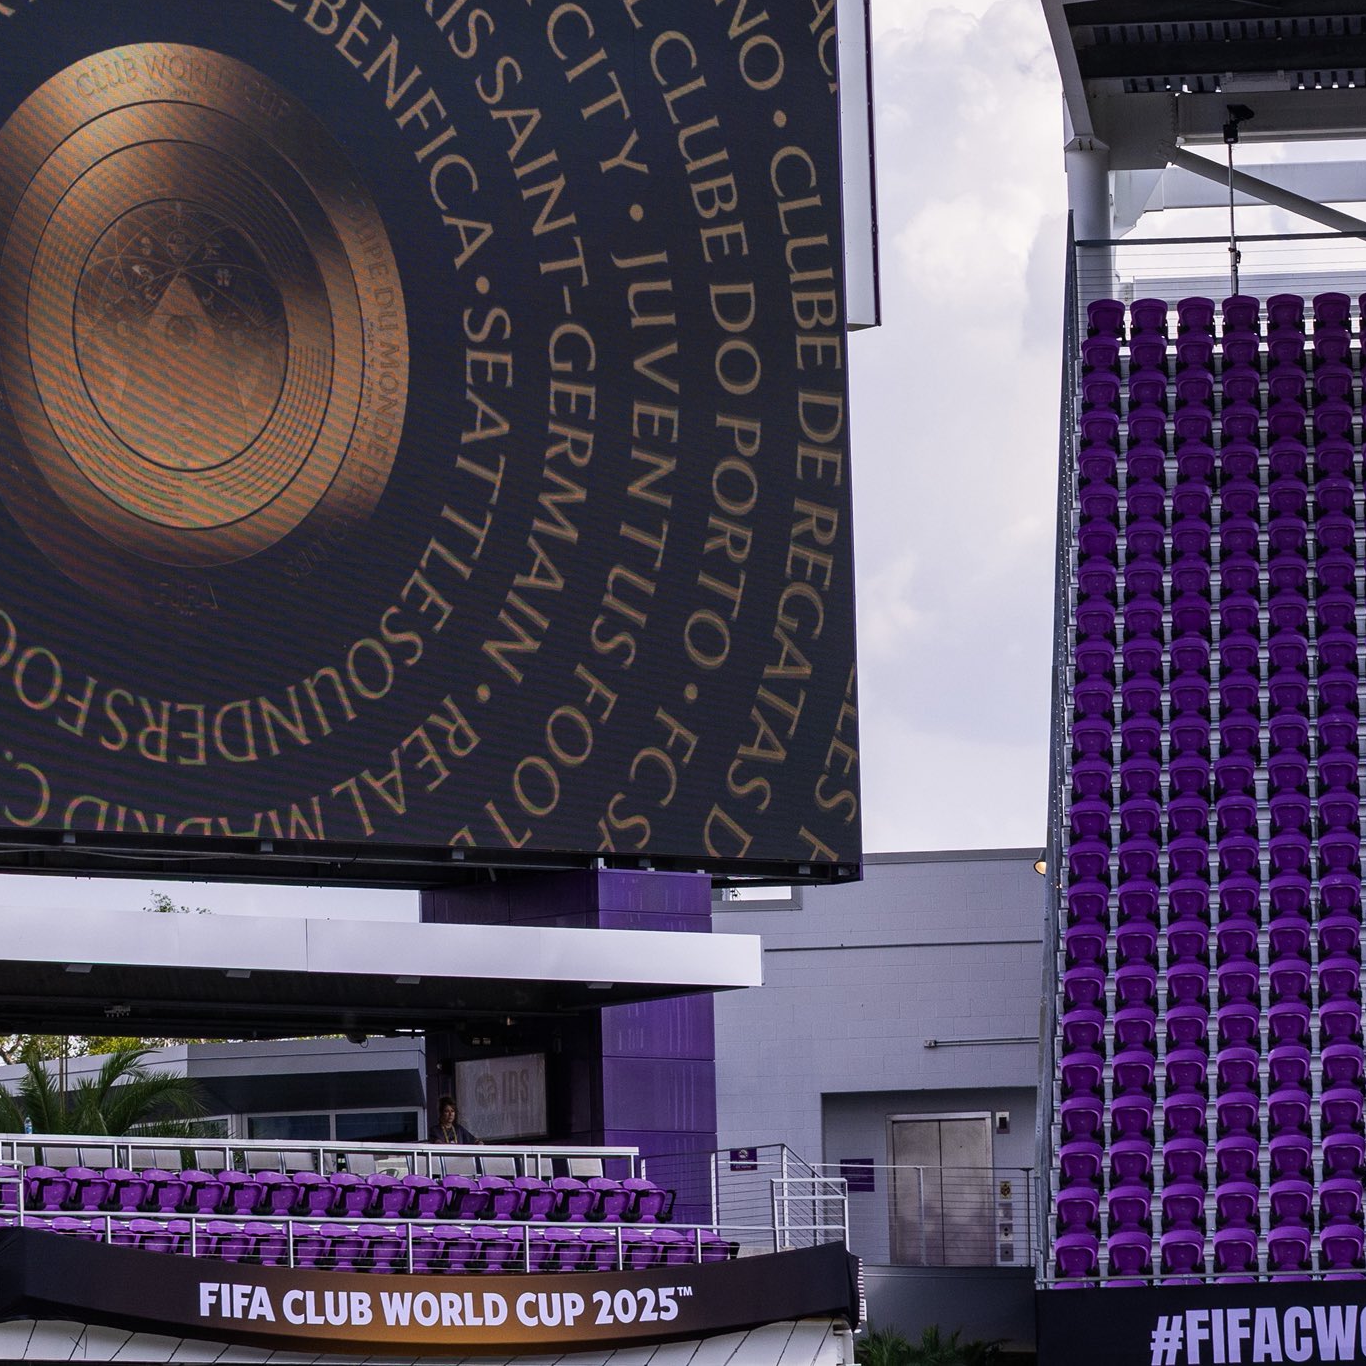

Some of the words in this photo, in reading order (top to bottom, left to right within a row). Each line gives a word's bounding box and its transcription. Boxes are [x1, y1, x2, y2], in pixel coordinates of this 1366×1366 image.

[546, 2, 649, 177] CITY
[649, 30, 748, 263] CLUBE
[709, 282, 762, 396] DO
[769, 145, 843, 378] CLUBE
[475, 56, 597, 683] SAINT-GERMAIN
[591, 249, 679, 668] JUVENTUS
[795, 390, 844, 486] DE
[684, 413, 762, 669] PORTO
[629, 707, 699, 808] FC
[727, 497, 839, 814] REGATAS
[331, 695, 481, 836] REAL
[198, 1281, 276, 1322] FIFA
[283, 1290, 373, 1326] CLUB
[379, 1291, 508, 1327] WORLD
[516, 1291, 585, 1327] CUP
